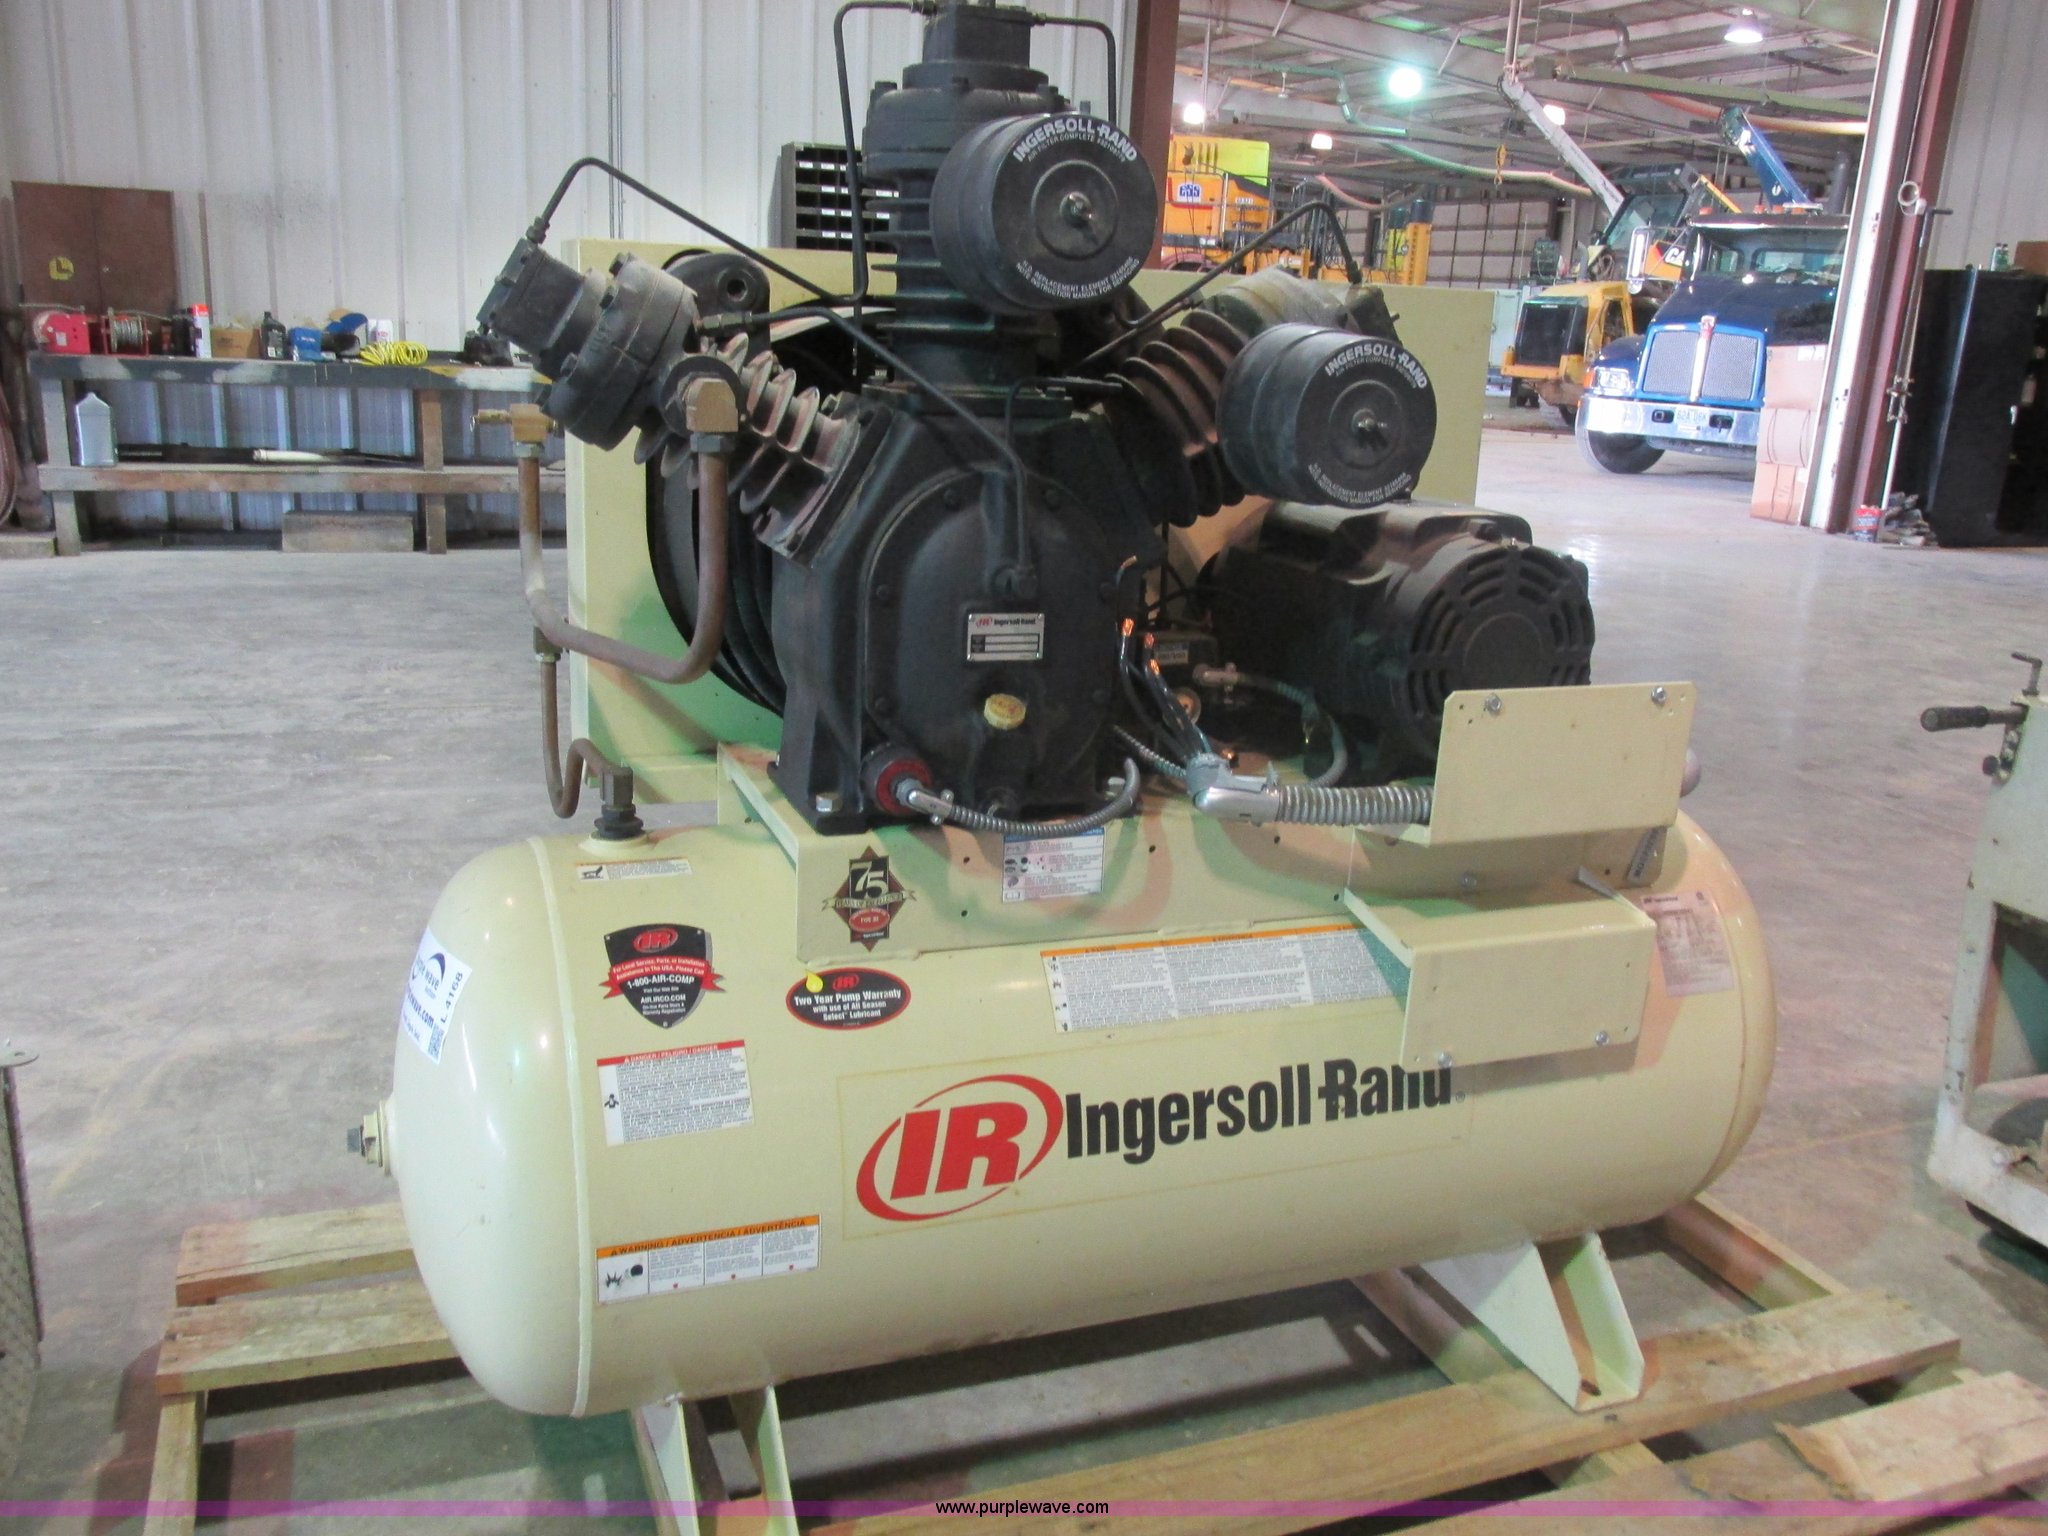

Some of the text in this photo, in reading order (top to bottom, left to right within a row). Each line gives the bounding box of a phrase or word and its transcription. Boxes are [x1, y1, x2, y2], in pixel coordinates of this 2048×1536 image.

[1059, 133, 1095, 142] COMPLETE
[850, 861, 888, 897] 75
[693, 967, 705, 975] Call
[626, 974, 695, 989] 1-800-AIR-COMP
[793, 989, 901, 1006] Two Year Pump Warranty
[812, 1005, 828, 1013] with
[851, 1002, 861, 1010] All
[862, 1000, 886, 1009] Season
[849, 1009, 881, 1019] Lubricant
[630, 1052, 657, 1062] DANGER
[692, 1045, 718, 1053] DANGER
[1067, 1062, 1311, 1164] Ingersoll
[618, 1240, 665, 1254] WARNING
[671, 1229, 736, 1246] ADVERTENCIA
